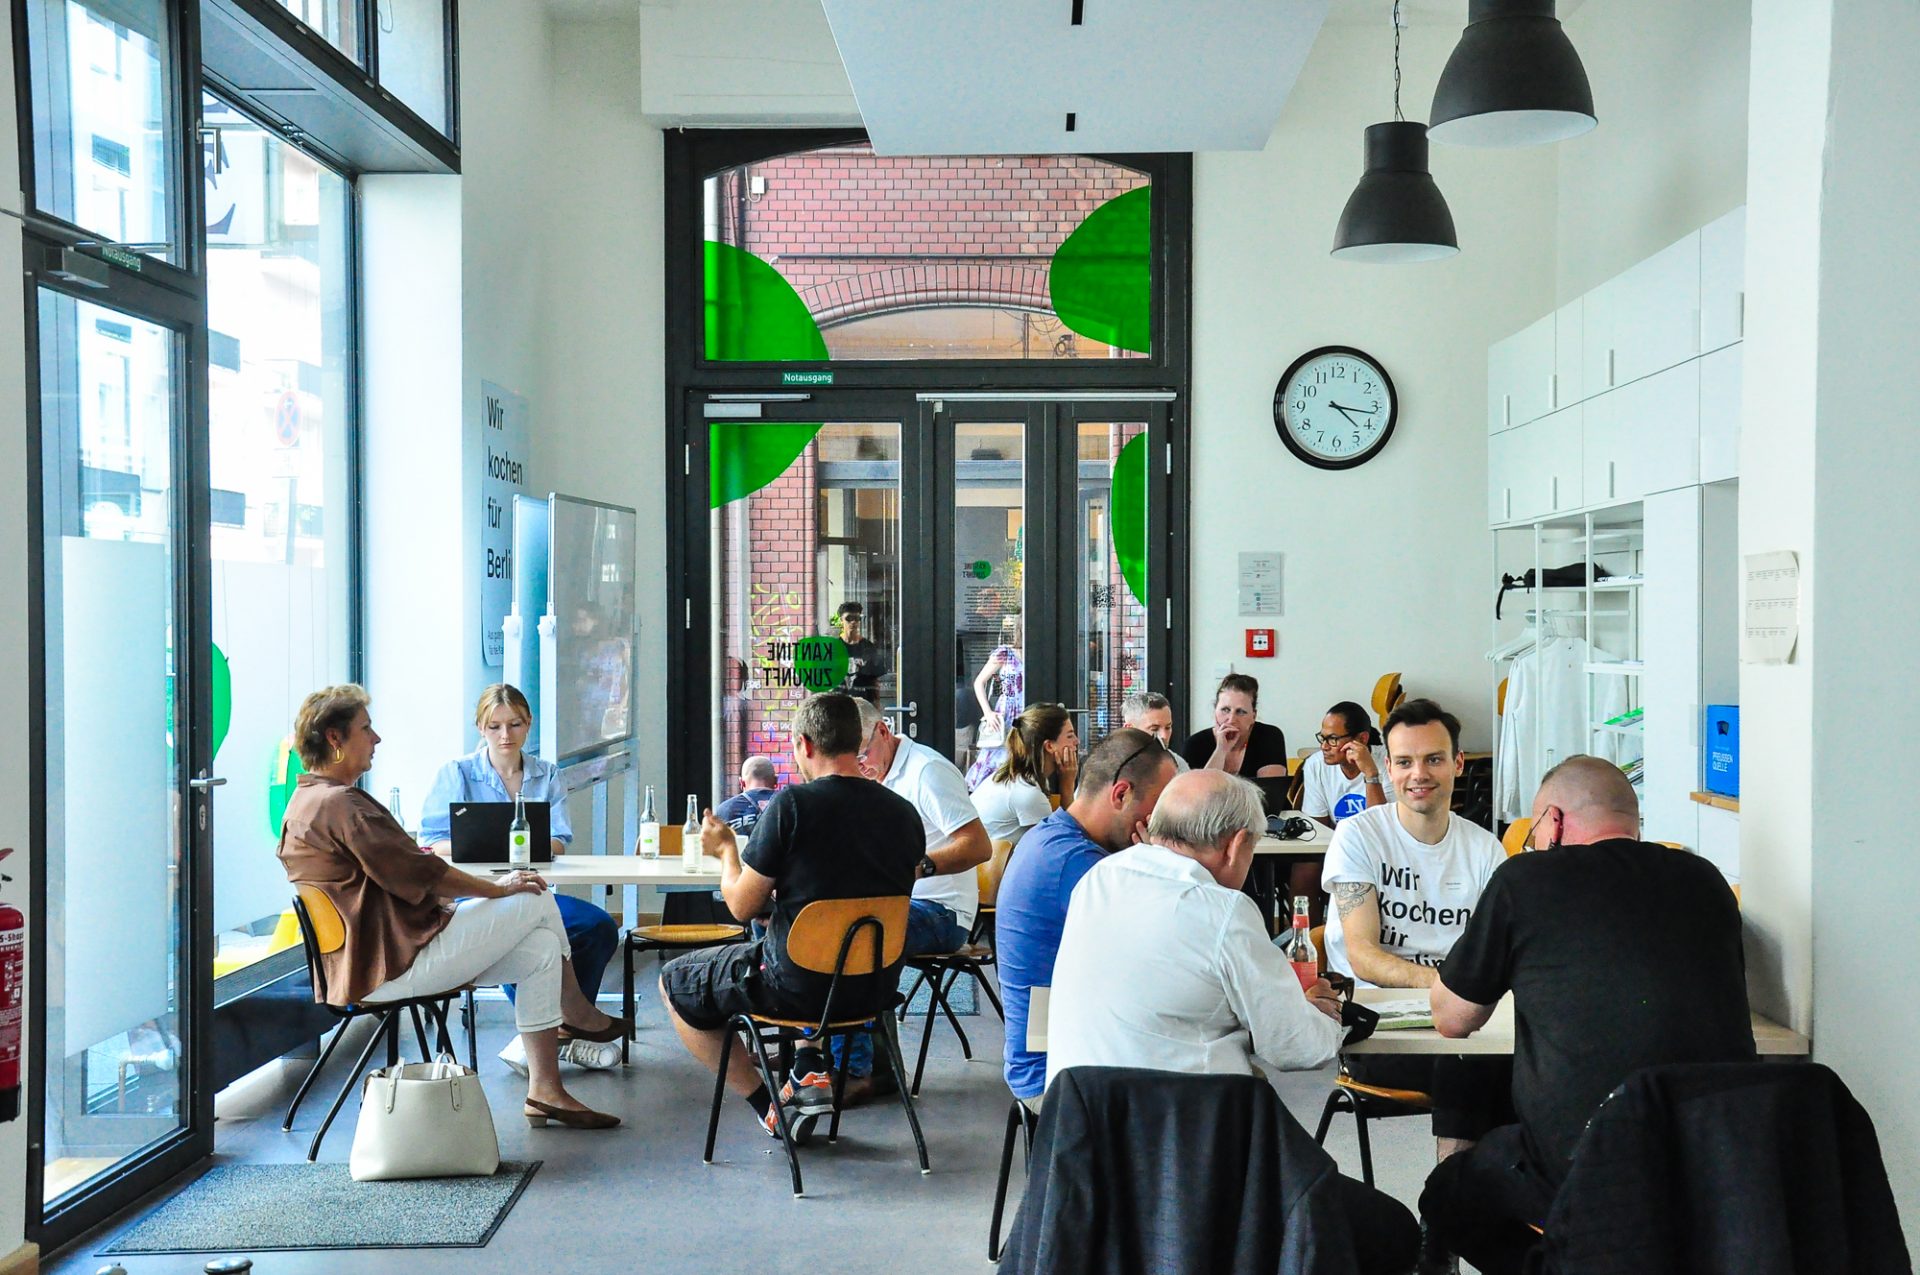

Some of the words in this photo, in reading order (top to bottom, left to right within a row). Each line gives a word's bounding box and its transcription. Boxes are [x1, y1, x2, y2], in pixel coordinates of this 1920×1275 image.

[784, 372, 832, 384] Notausgang
[1316, 372, 1327, 384] 11
[1331, 366, 1345, 378] 12
[1353, 371, 1357, 383] 1
[1303, 385, 1317, 397] 10
[1363, 382, 1372, 394] 2
[1296, 401, 1306, 413] 9
[1371, 400, 1379, 413] 3
[487, 396, 504, 430] Wir
[1302, 418, 1311, 430] 8
[1363, 418, 1372, 430] 4
[1316, 430, 1325, 442] 7
[1332, 435, 1341, 447] 6
[1352, 431, 1360, 443] 5
[488, 445, 523, 485] kochen
[487, 496, 502, 529] für
[487, 548, 512, 580] Berli
[1382, 863, 1420, 890] Wir
[1379, 891, 1471, 926] kochen
[1379, 925, 1409, 947] ür
